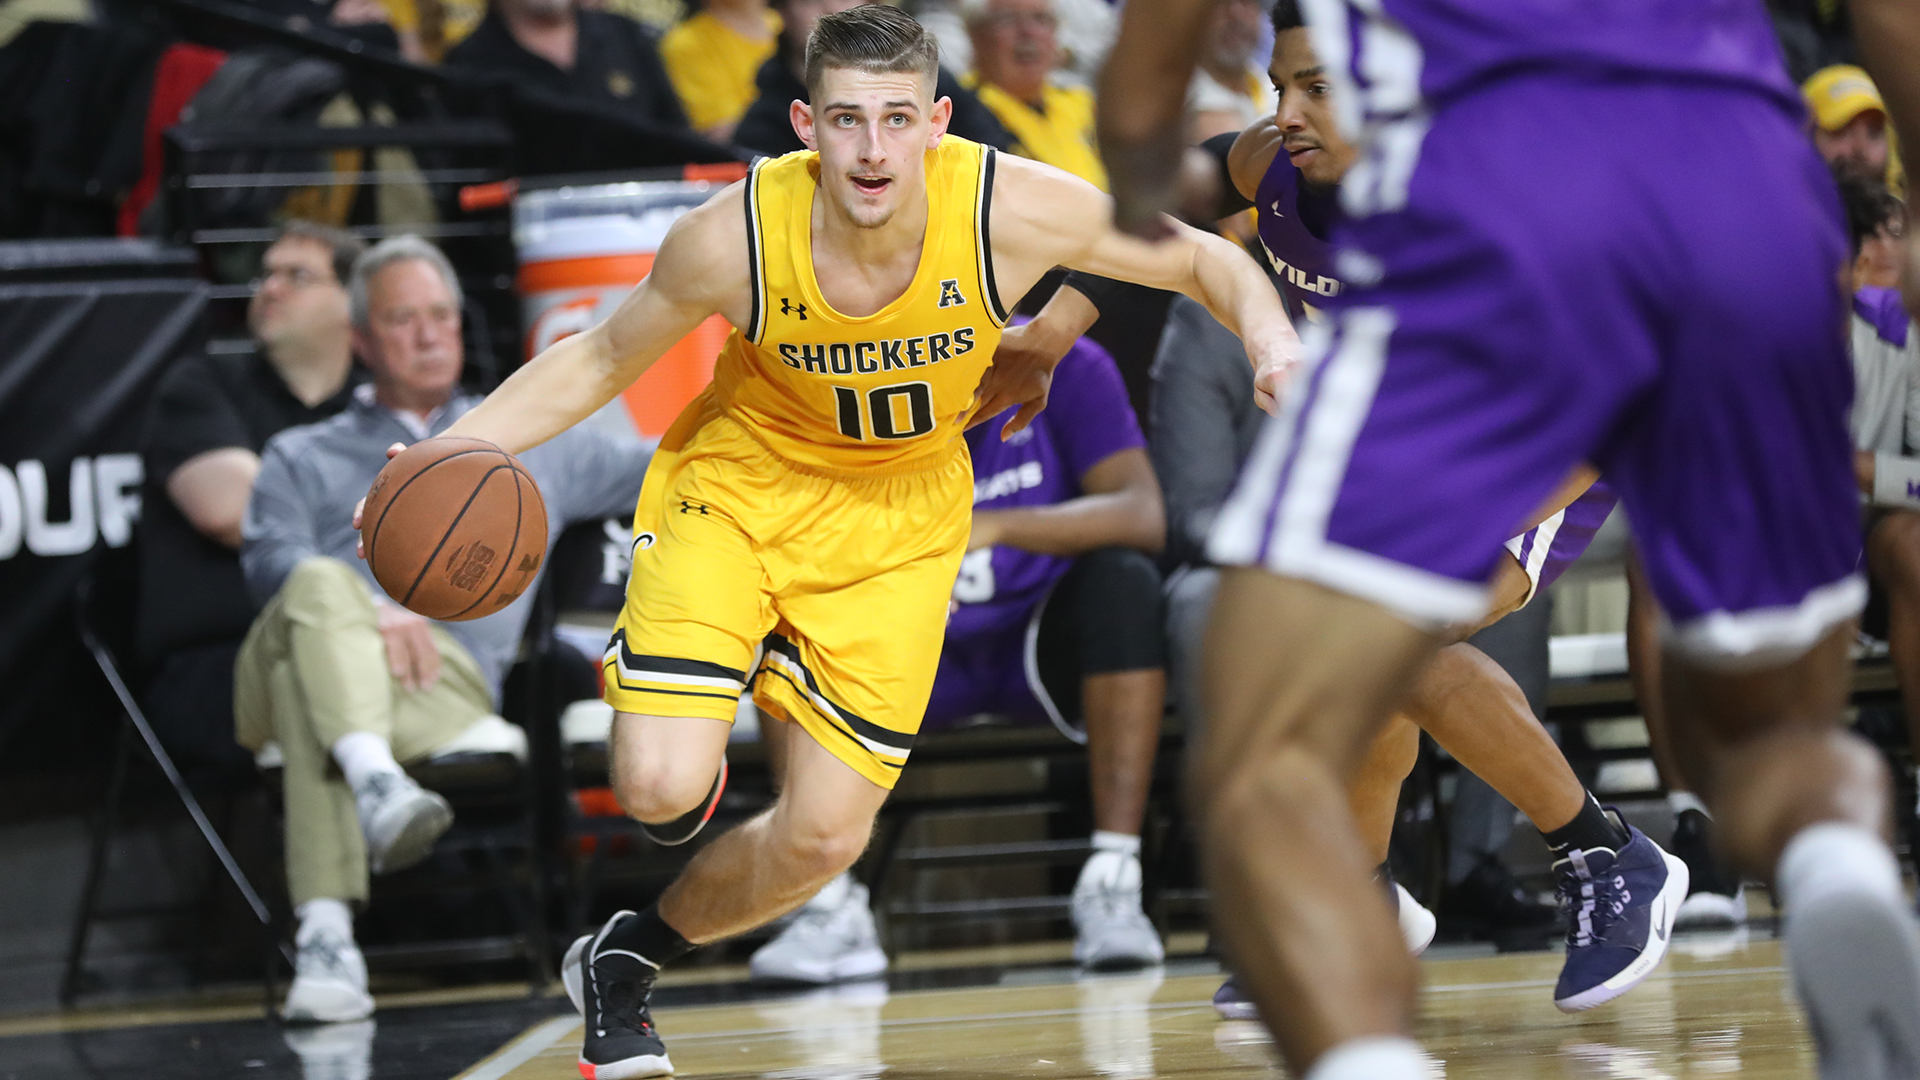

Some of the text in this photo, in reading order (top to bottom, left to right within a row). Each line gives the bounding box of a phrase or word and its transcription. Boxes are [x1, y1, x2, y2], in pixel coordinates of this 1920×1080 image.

[937, 278, 967, 308] A
[1258, 234, 1346, 297] WILD
[778, 327, 975, 375] SHOCKERS
[831, 380, 936, 442] 10
